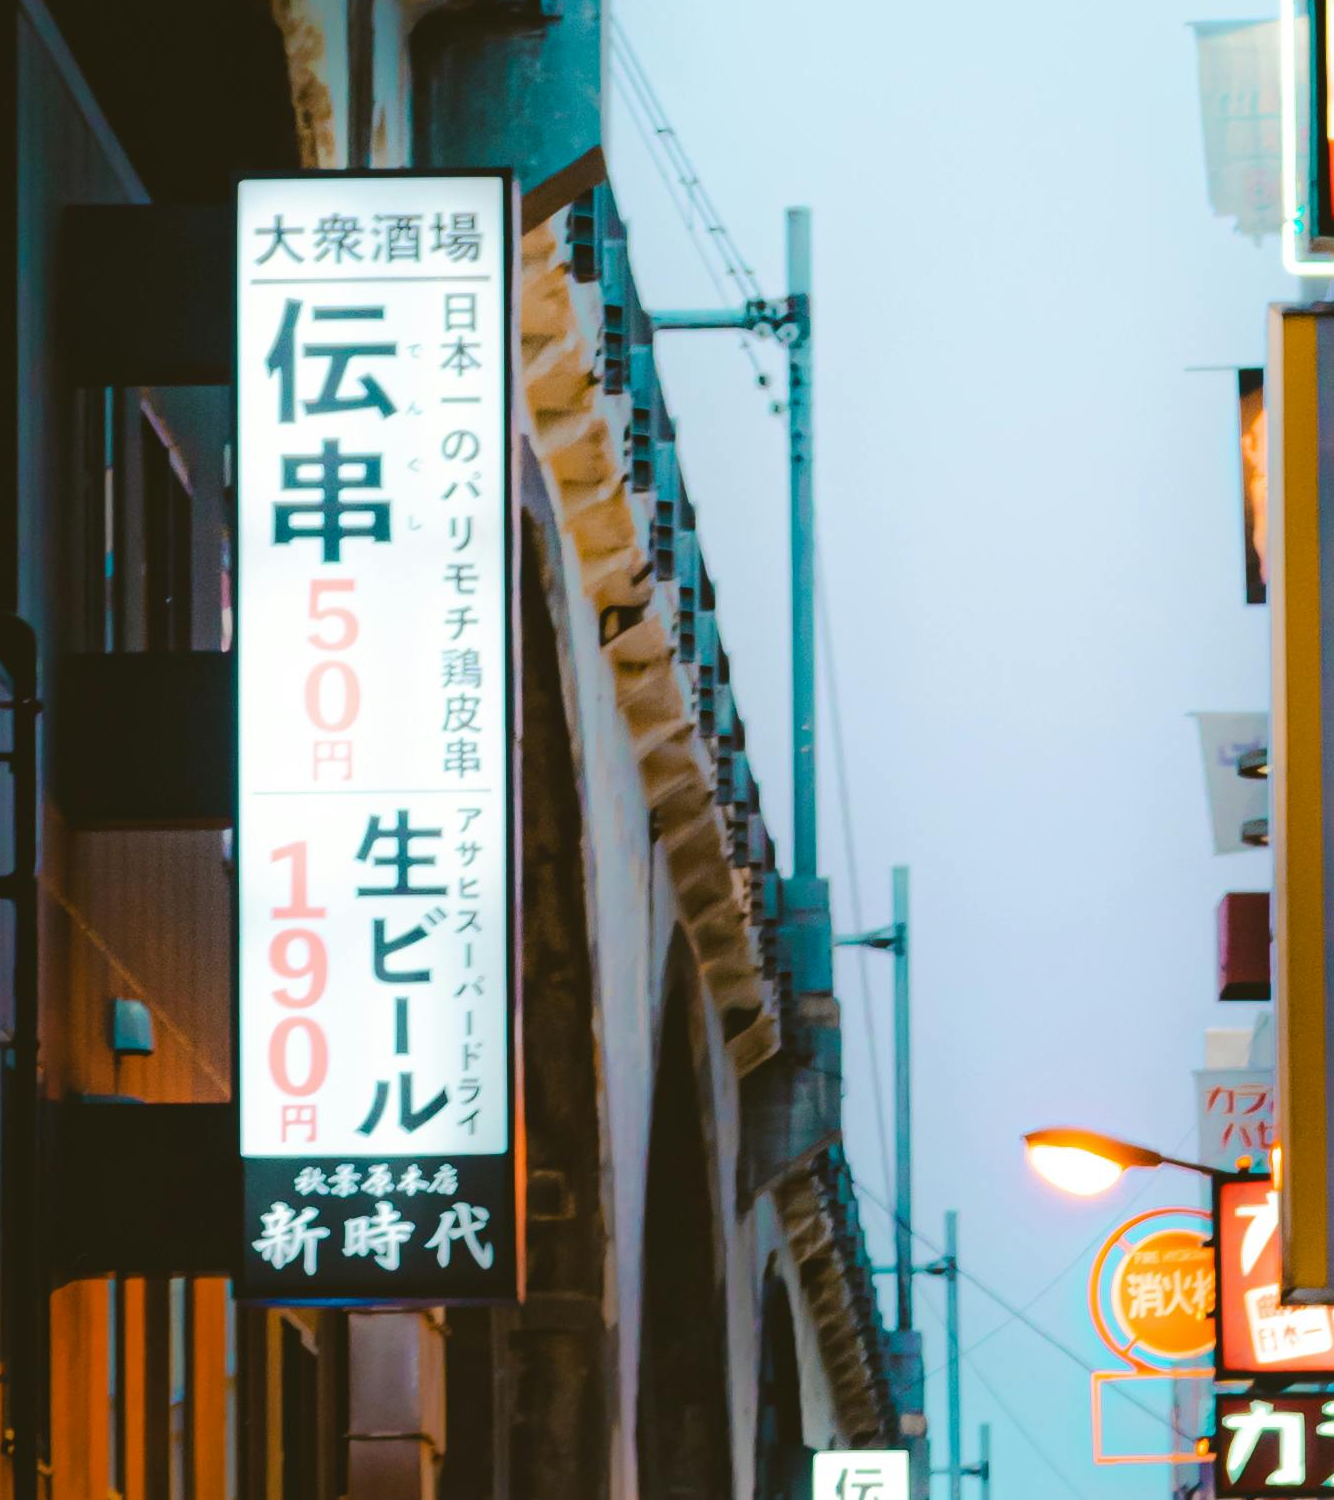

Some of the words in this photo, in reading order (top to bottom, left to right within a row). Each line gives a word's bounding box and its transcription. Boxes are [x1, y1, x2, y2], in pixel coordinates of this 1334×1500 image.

[254, 212, 485, 266] 大衆酒場
[266, 297, 400, 563] 伝串
[355, 809, 451, 1136] 生ビール
[294, 1163, 459, 1197] 秋葉原本店
[252, 1201, 494, 1276] 新時代
